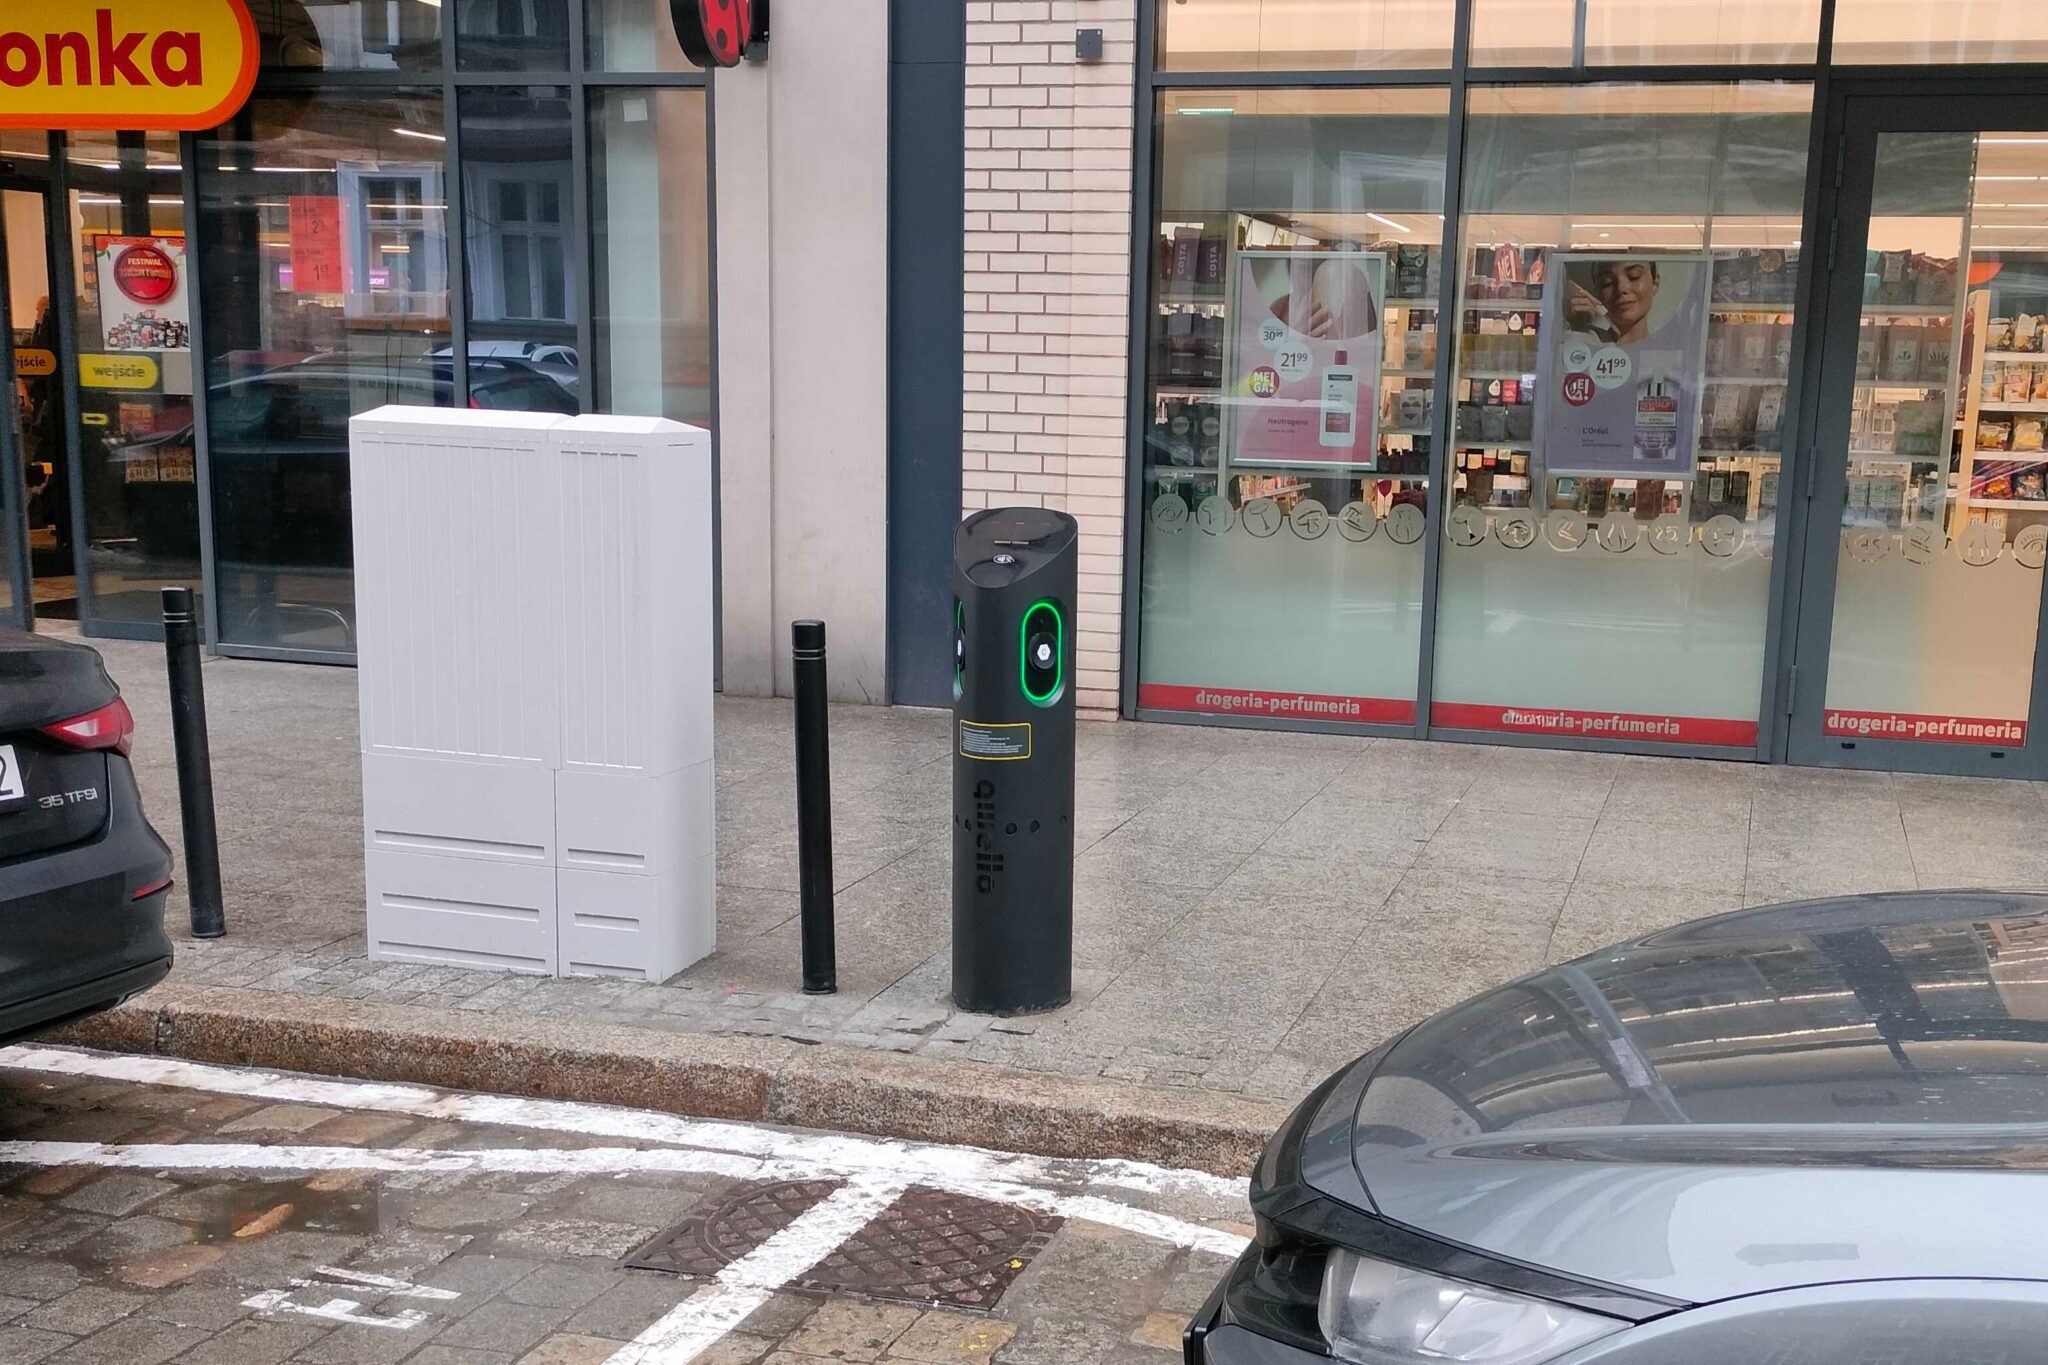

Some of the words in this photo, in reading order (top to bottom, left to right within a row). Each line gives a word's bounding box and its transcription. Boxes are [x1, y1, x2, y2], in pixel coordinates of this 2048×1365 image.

[0, 9, 203, 87] onka
[127, 257, 163, 266] FESTIWAL
[1177, 243, 1187, 275] COSTA
[1209, 246, 1218, 278] COSTA
[93, 364, 146, 380] wejście
[1267, 417, 1309, 427] Neutrogena
[1195, 690, 1361, 715] drogeria-perfumeria
[1827, 713, 2022, 740] drogeria-perfumeria
[38, 795, 64, 809] 35
[65, 787, 98, 803] TFSI
